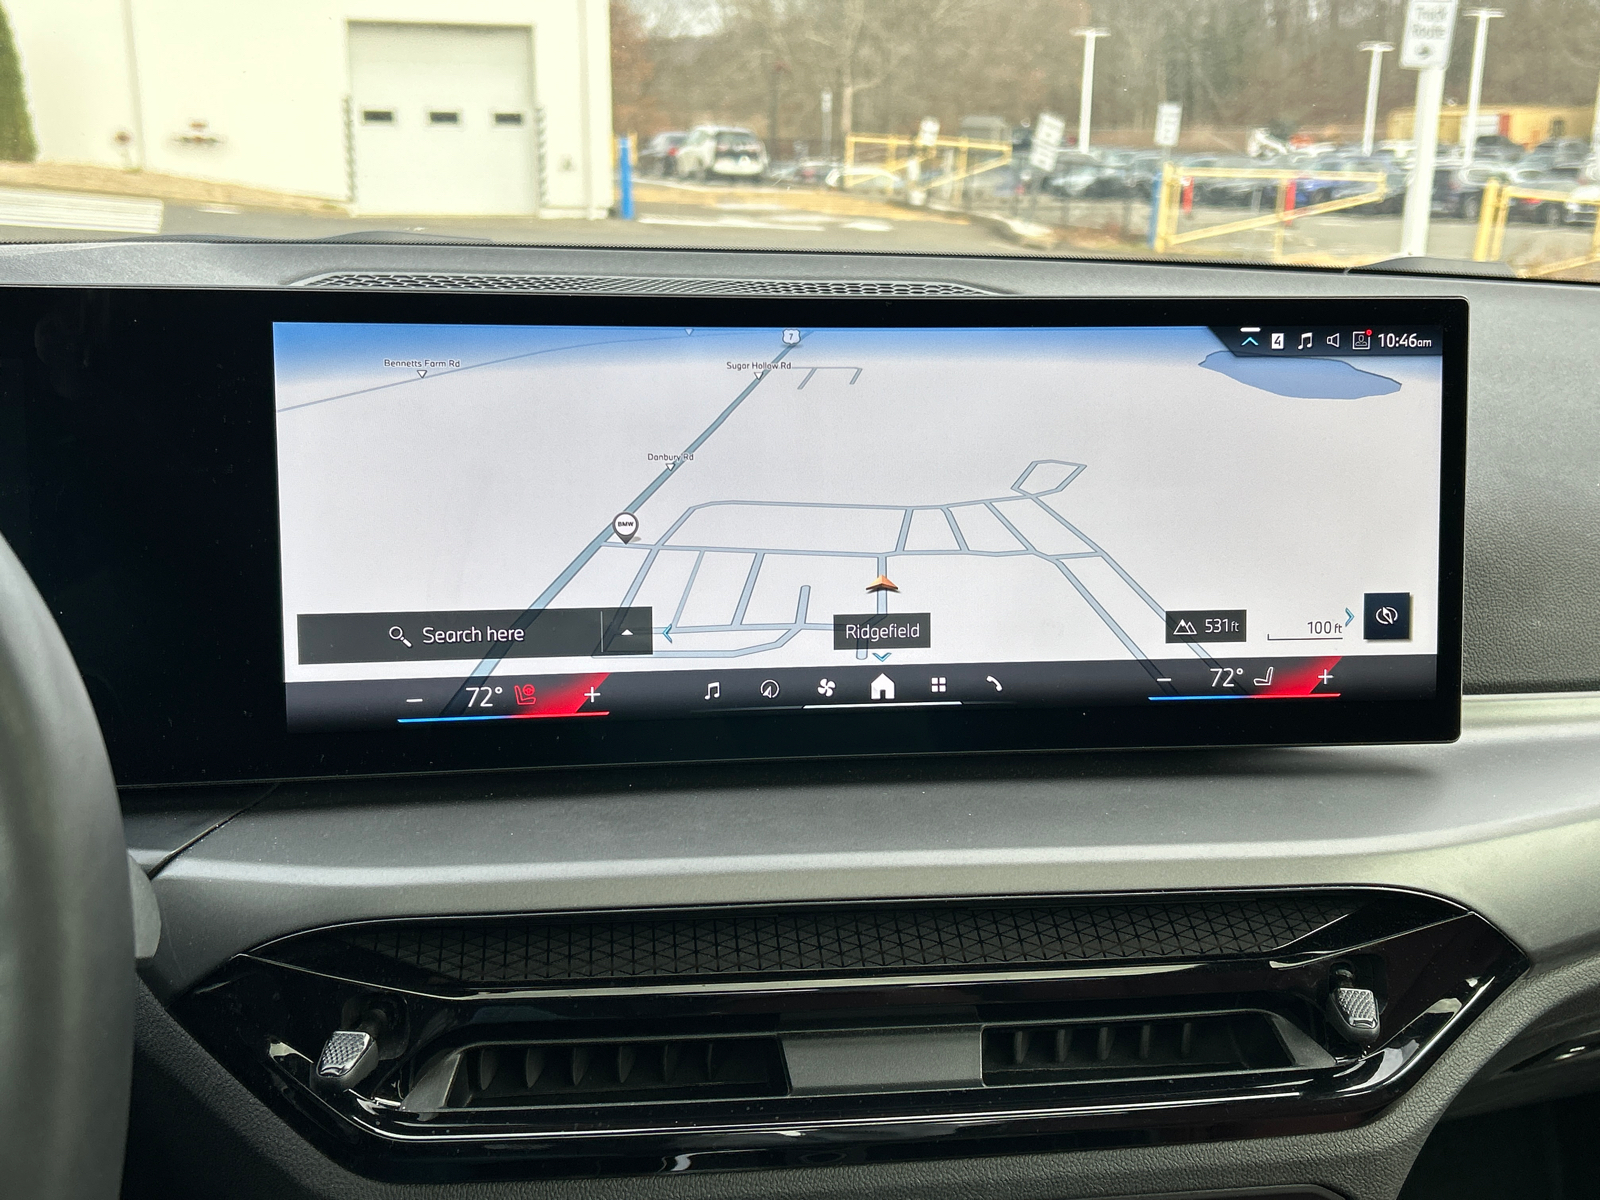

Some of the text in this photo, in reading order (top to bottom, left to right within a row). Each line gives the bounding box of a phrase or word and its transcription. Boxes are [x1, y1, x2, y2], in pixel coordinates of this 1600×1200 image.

[1378, 333, 1432, 348] 10:46am
[384, 359, 460, 368] Bennetts Farm Rd
[726, 361, 792, 371] Sugar Hollow Rd
[647, 452, 694, 462] Danbury Rd
[422, 625, 525, 644] Search here
[845, 622, 920, 642] Ridgefield
